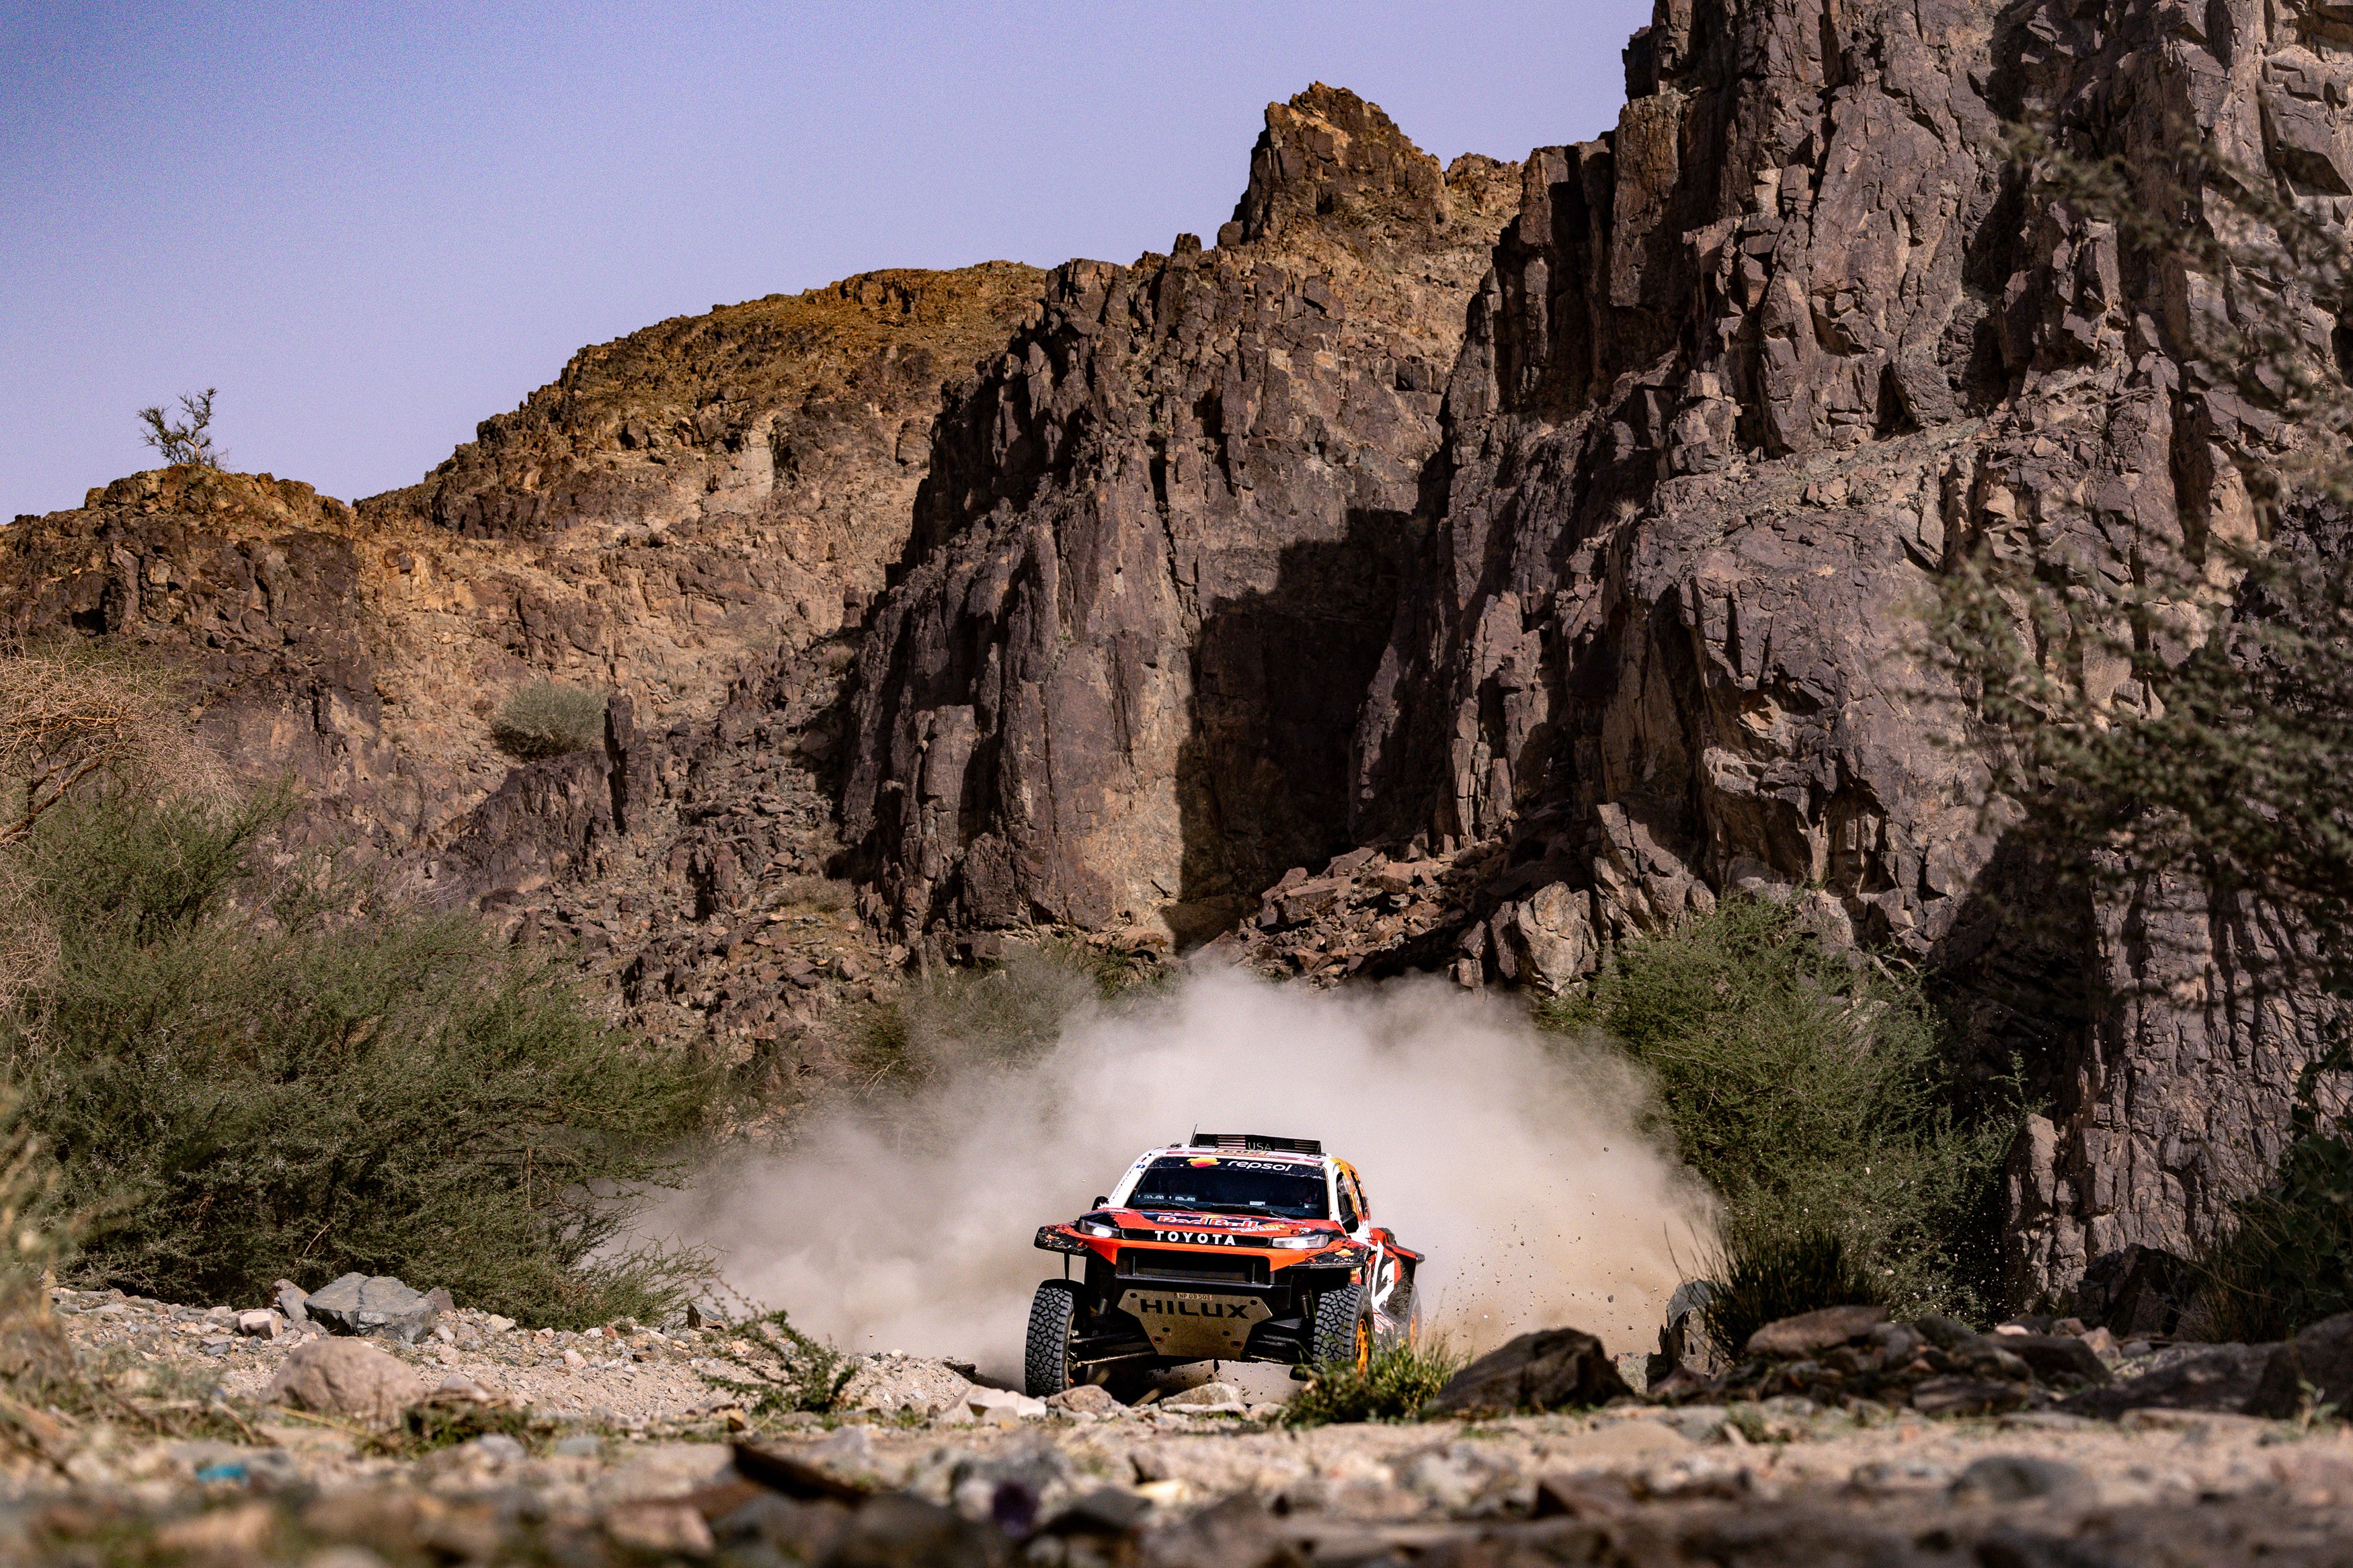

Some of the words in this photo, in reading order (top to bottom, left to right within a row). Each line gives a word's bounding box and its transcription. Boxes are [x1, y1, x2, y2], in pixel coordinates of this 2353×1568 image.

[1248, 1142, 1273, 1151] USA
[1227, 1160, 1293, 1171] repsol
[1157, 1215, 1209, 1225] Red
[1209, 1218, 1259, 1228] Bull
[1154, 1230, 1236, 1246] TOYOTA
[1140, 1298, 1249, 1319] HILUX
